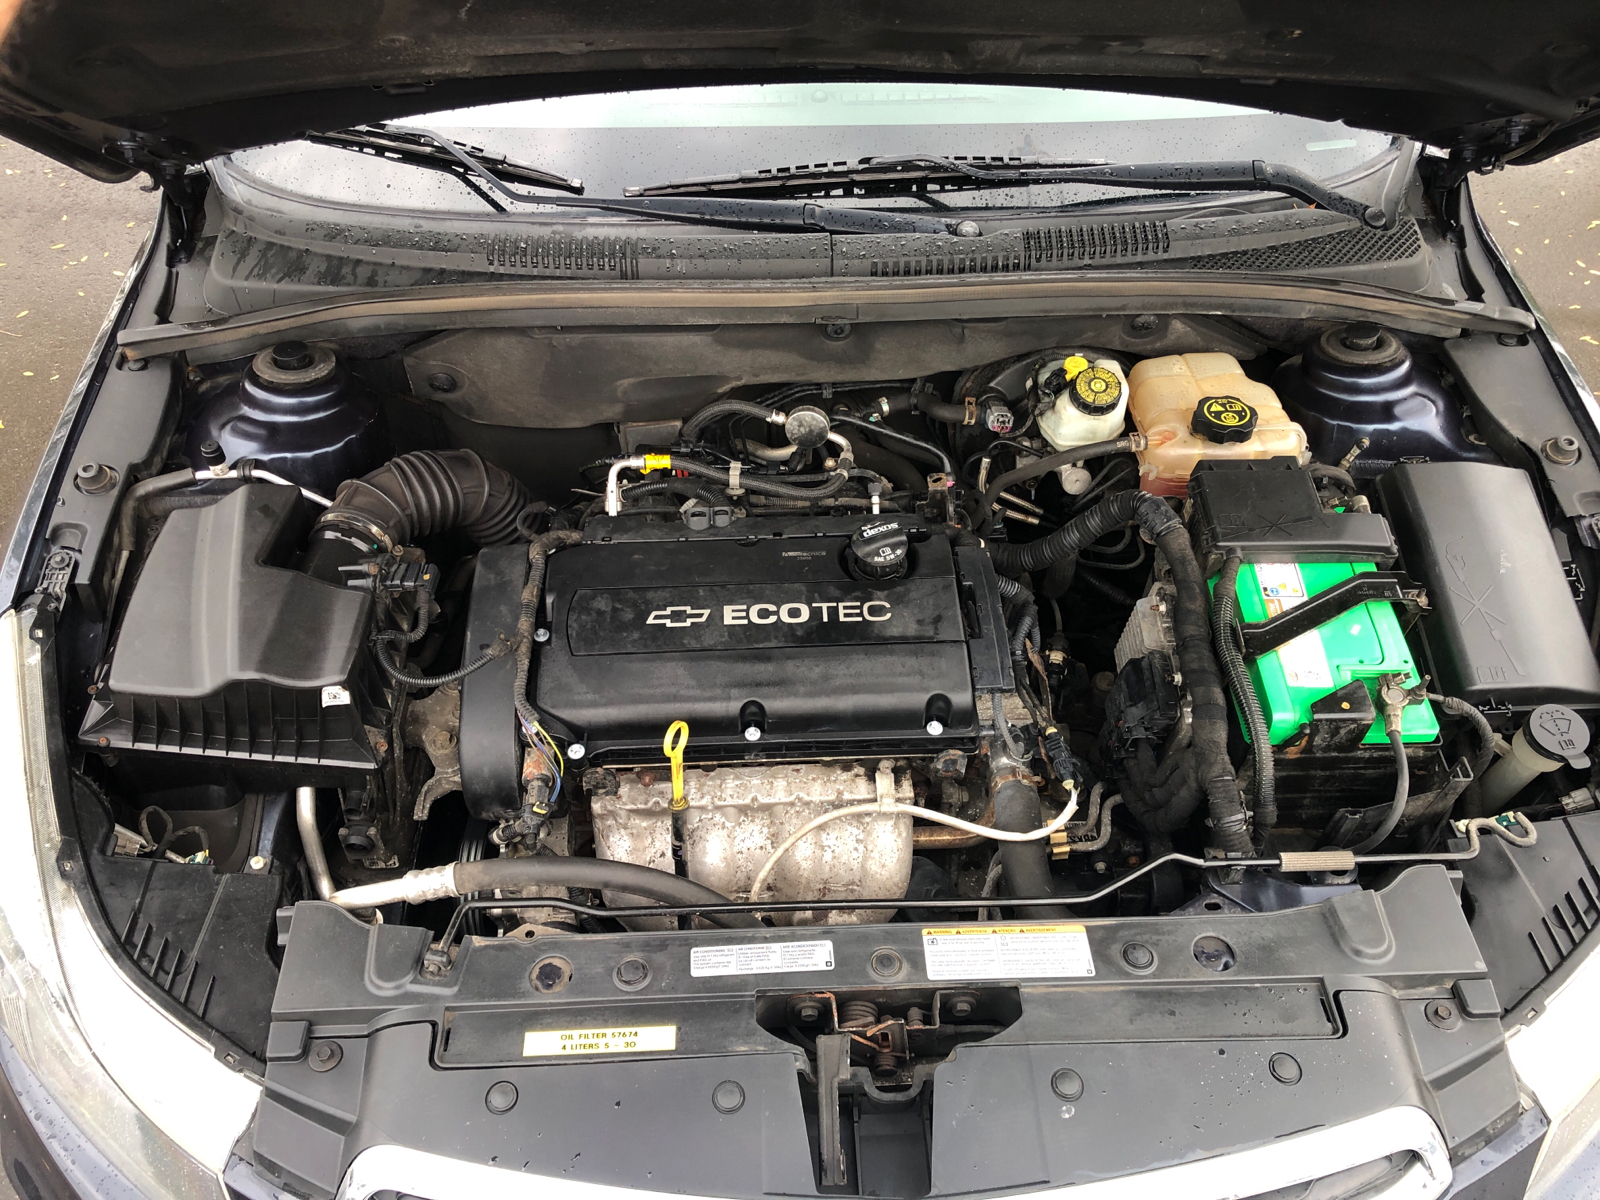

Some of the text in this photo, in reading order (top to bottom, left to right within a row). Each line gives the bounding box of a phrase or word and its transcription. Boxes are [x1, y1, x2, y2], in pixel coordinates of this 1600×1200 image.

[863, 522, 899, 537] dexos
[723, 601, 892, 626] ECOTEC
[560, 1033, 574, 1041] OIL
[611, 1031, 638, 1039] 57674
